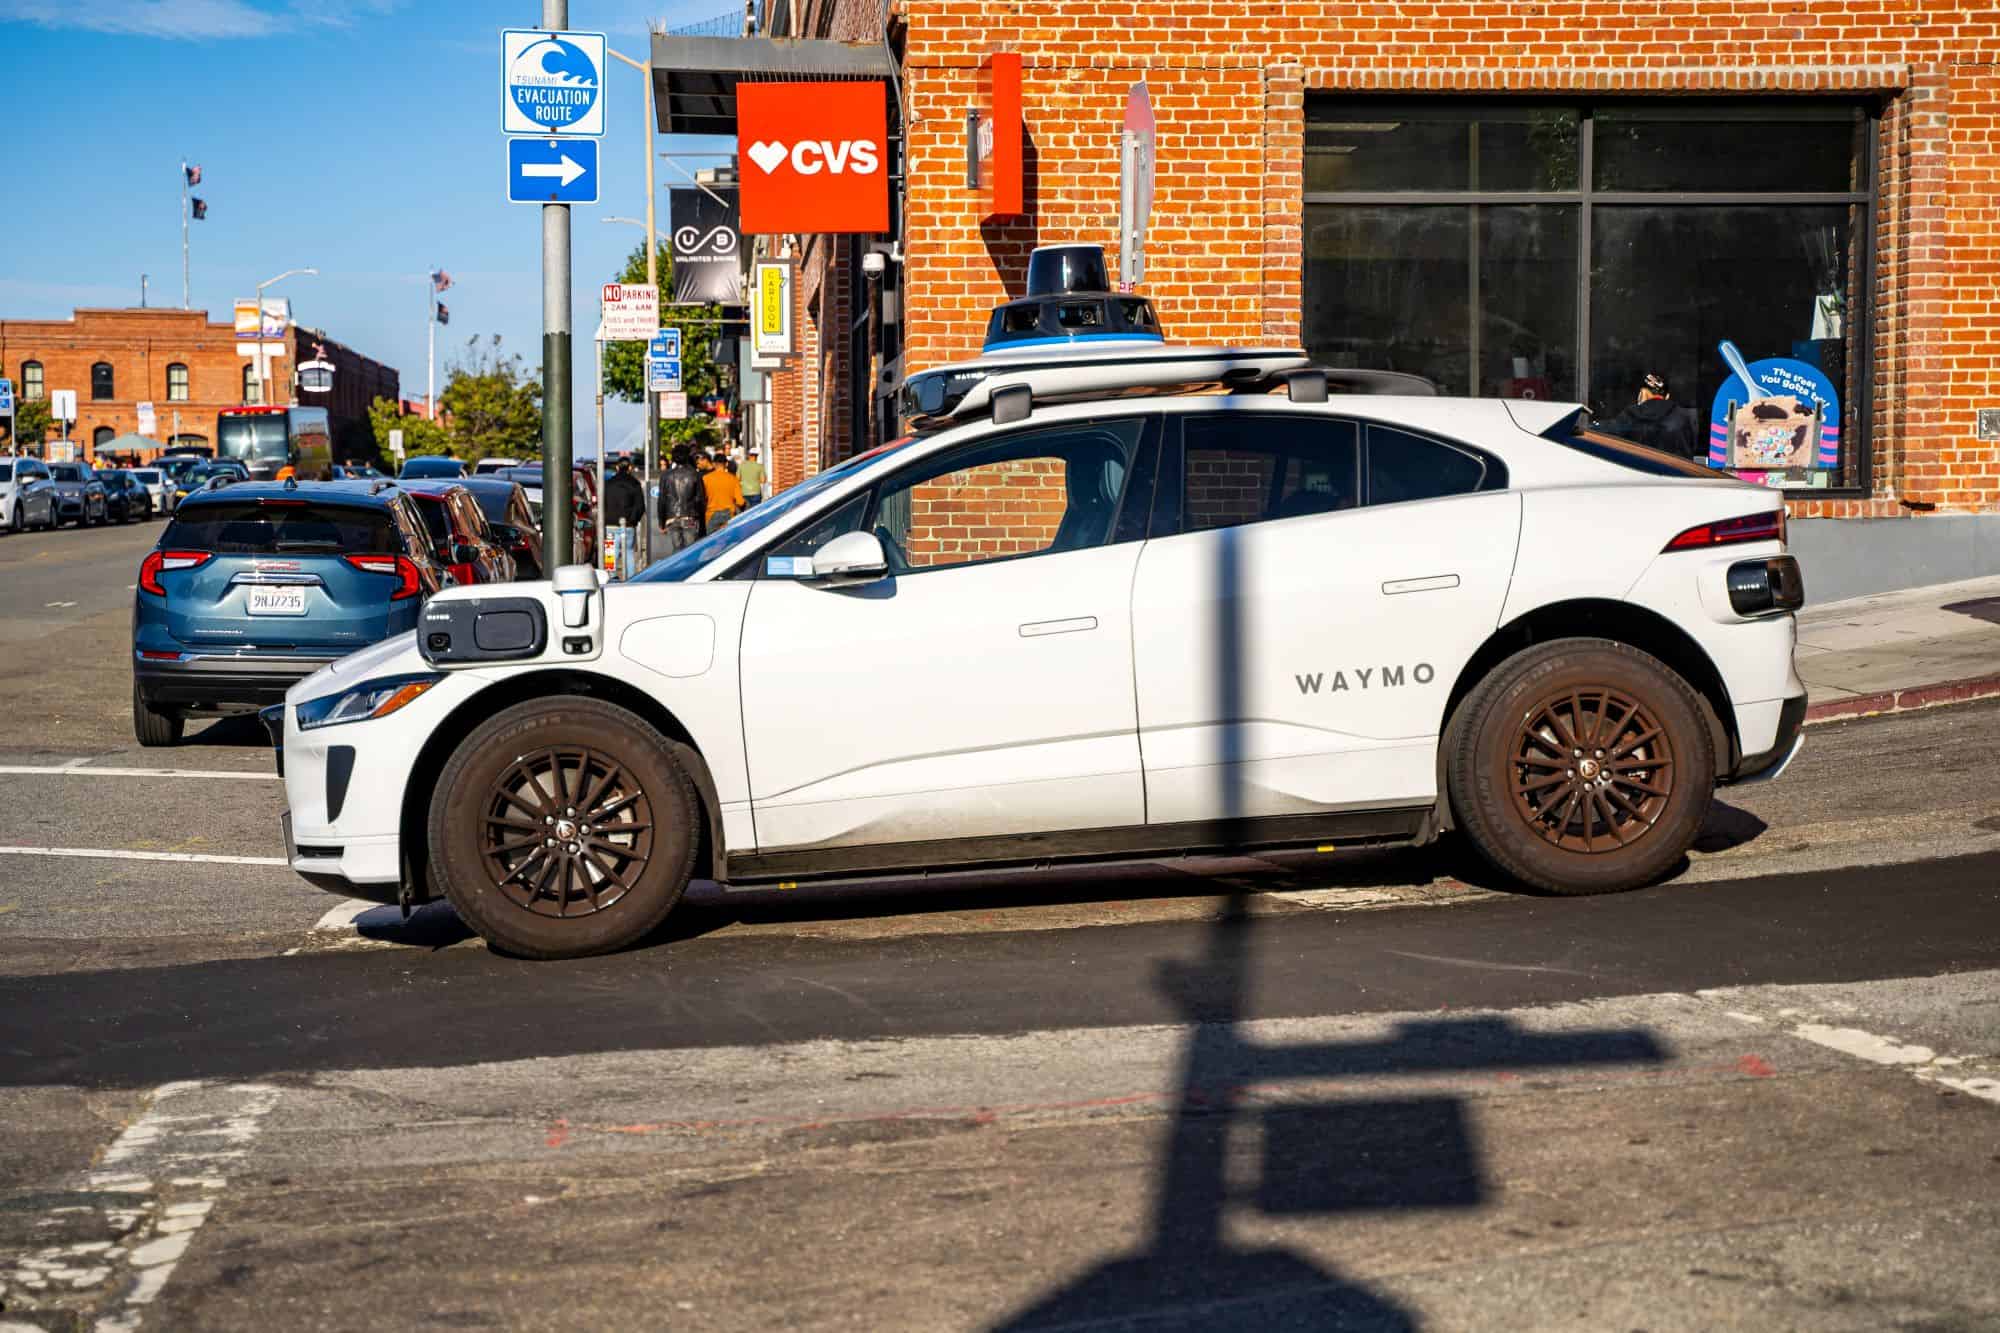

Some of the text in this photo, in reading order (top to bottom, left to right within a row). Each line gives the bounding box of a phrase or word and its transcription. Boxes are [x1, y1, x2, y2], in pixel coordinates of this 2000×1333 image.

[516, 75, 557, 84] TSUNAMI
[518, 88, 590, 105] EVACUATION
[535, 106, 572, 121] ROUTE
[791, 140, 879, 175] CVS
[605, 287, 657, 300] NO PARKING
[768, 272, 776, 329] CARTOON
[1773, 367, 1792, 379] The
[1782, 379, 1809, 396] gotta
[1295, 662, 1435, 695] WAYMO
